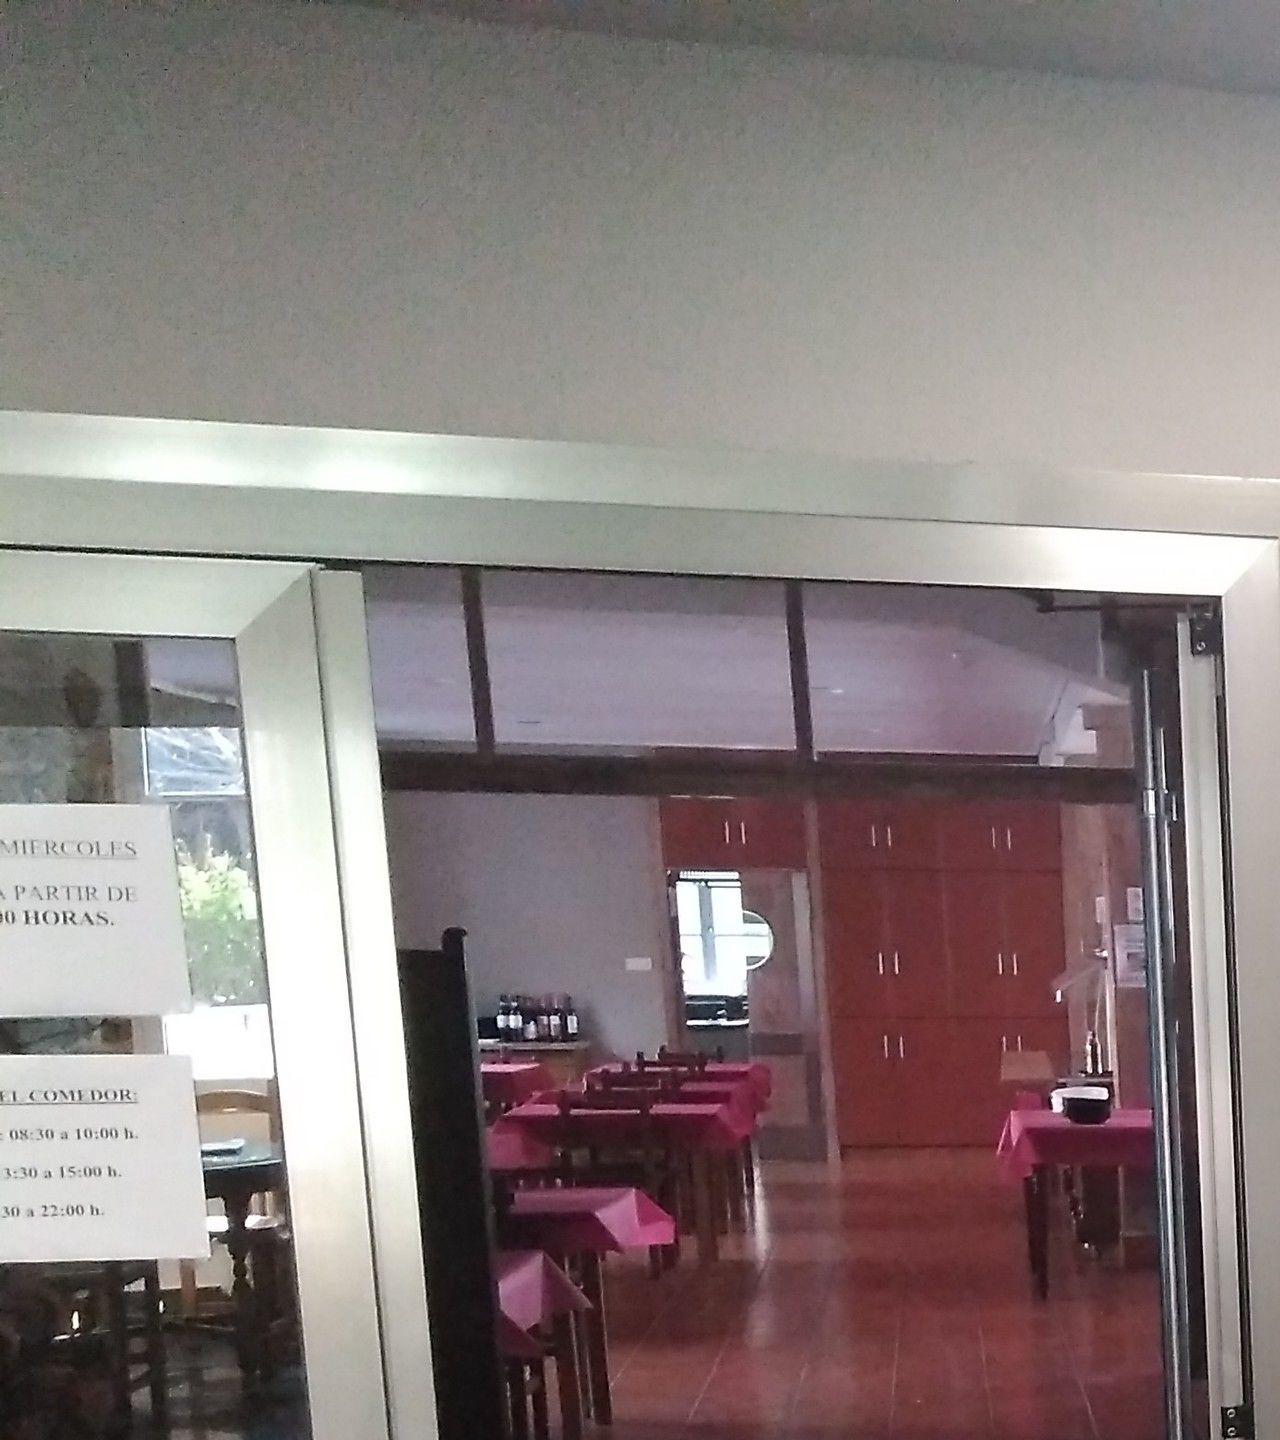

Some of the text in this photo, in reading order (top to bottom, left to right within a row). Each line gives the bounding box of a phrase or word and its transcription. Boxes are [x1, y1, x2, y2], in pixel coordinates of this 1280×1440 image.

[0, 839, 137, 857] MIERCOLES
[15, 884, 98, 901] PARTIR
[107, 885, 138, 902] DE
[24, 910, 115, 926] HORAS.
[9, 1127, 139, 1141] 08:30 a 10:00 h.
[60, 1166, 102, 1178] 15:00
[107, 1165, 122, 1178] h.
[41, 1204, 85, 1217] 22:00
[89, 1204, 105, 1216] h.
